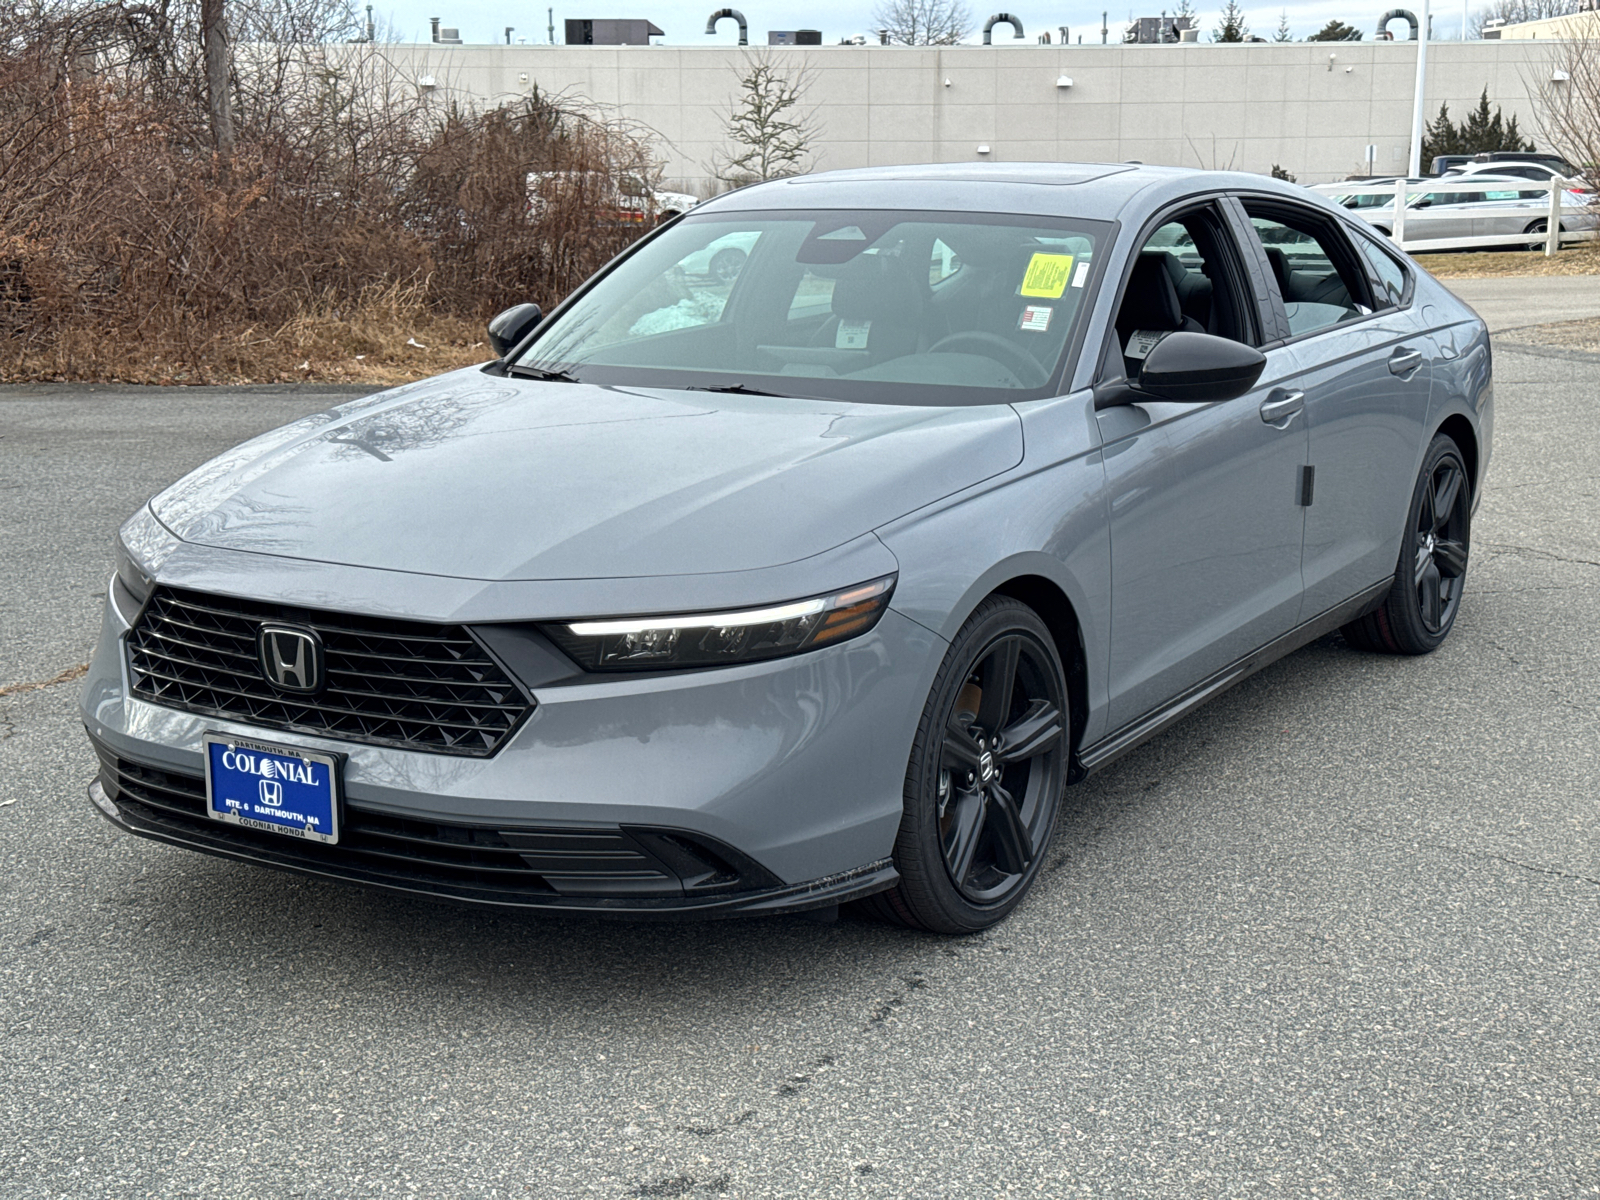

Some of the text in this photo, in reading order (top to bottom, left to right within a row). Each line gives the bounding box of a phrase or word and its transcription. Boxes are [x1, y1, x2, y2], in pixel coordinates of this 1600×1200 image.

[234, 740, 287, 756] DARTMOUTH,
[222, 751, 319, 786] COLONIAL
[225, 798, 320, 825] RTE. 6 DARTMOUTH, MA
[238, 817, 306, 838] COLONIAL HONDA
